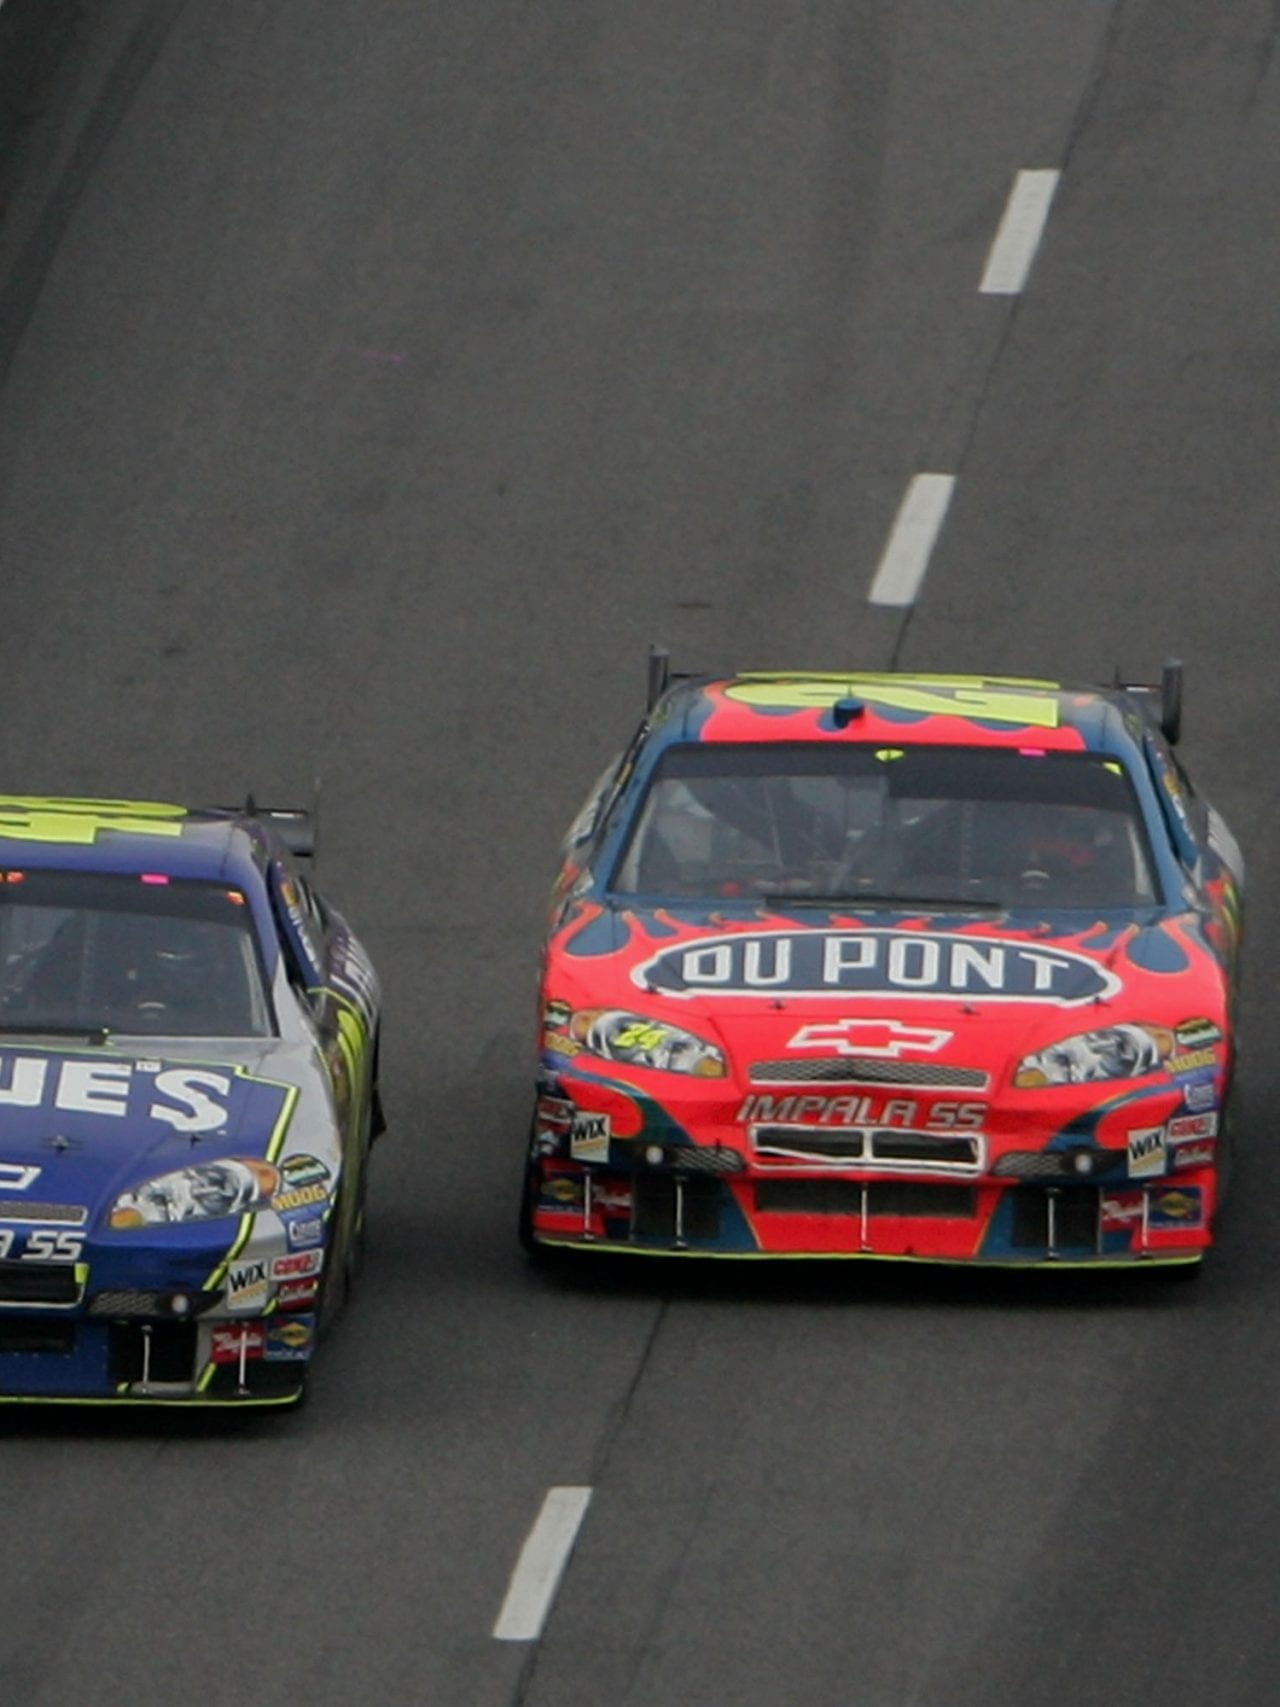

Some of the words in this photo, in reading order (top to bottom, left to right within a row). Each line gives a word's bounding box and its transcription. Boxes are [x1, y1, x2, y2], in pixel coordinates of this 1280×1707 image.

[682, 936, 792, 986] DU
[823, 934, 1072, 991] PONT
[612, 1021, 669, 1050] 24
[736, 1094, 916, 1126] IMPALA
[926, 1101, 990, 1129] SS
[573, 1116, 607, 1142] WIX
[1129, 1129, 1163, 1161] WIX
[272, 1184, 329, 1211] MOOG
[21, 1230, 87, 1261] SS
[229, 1261, 266, 1293] WIX
